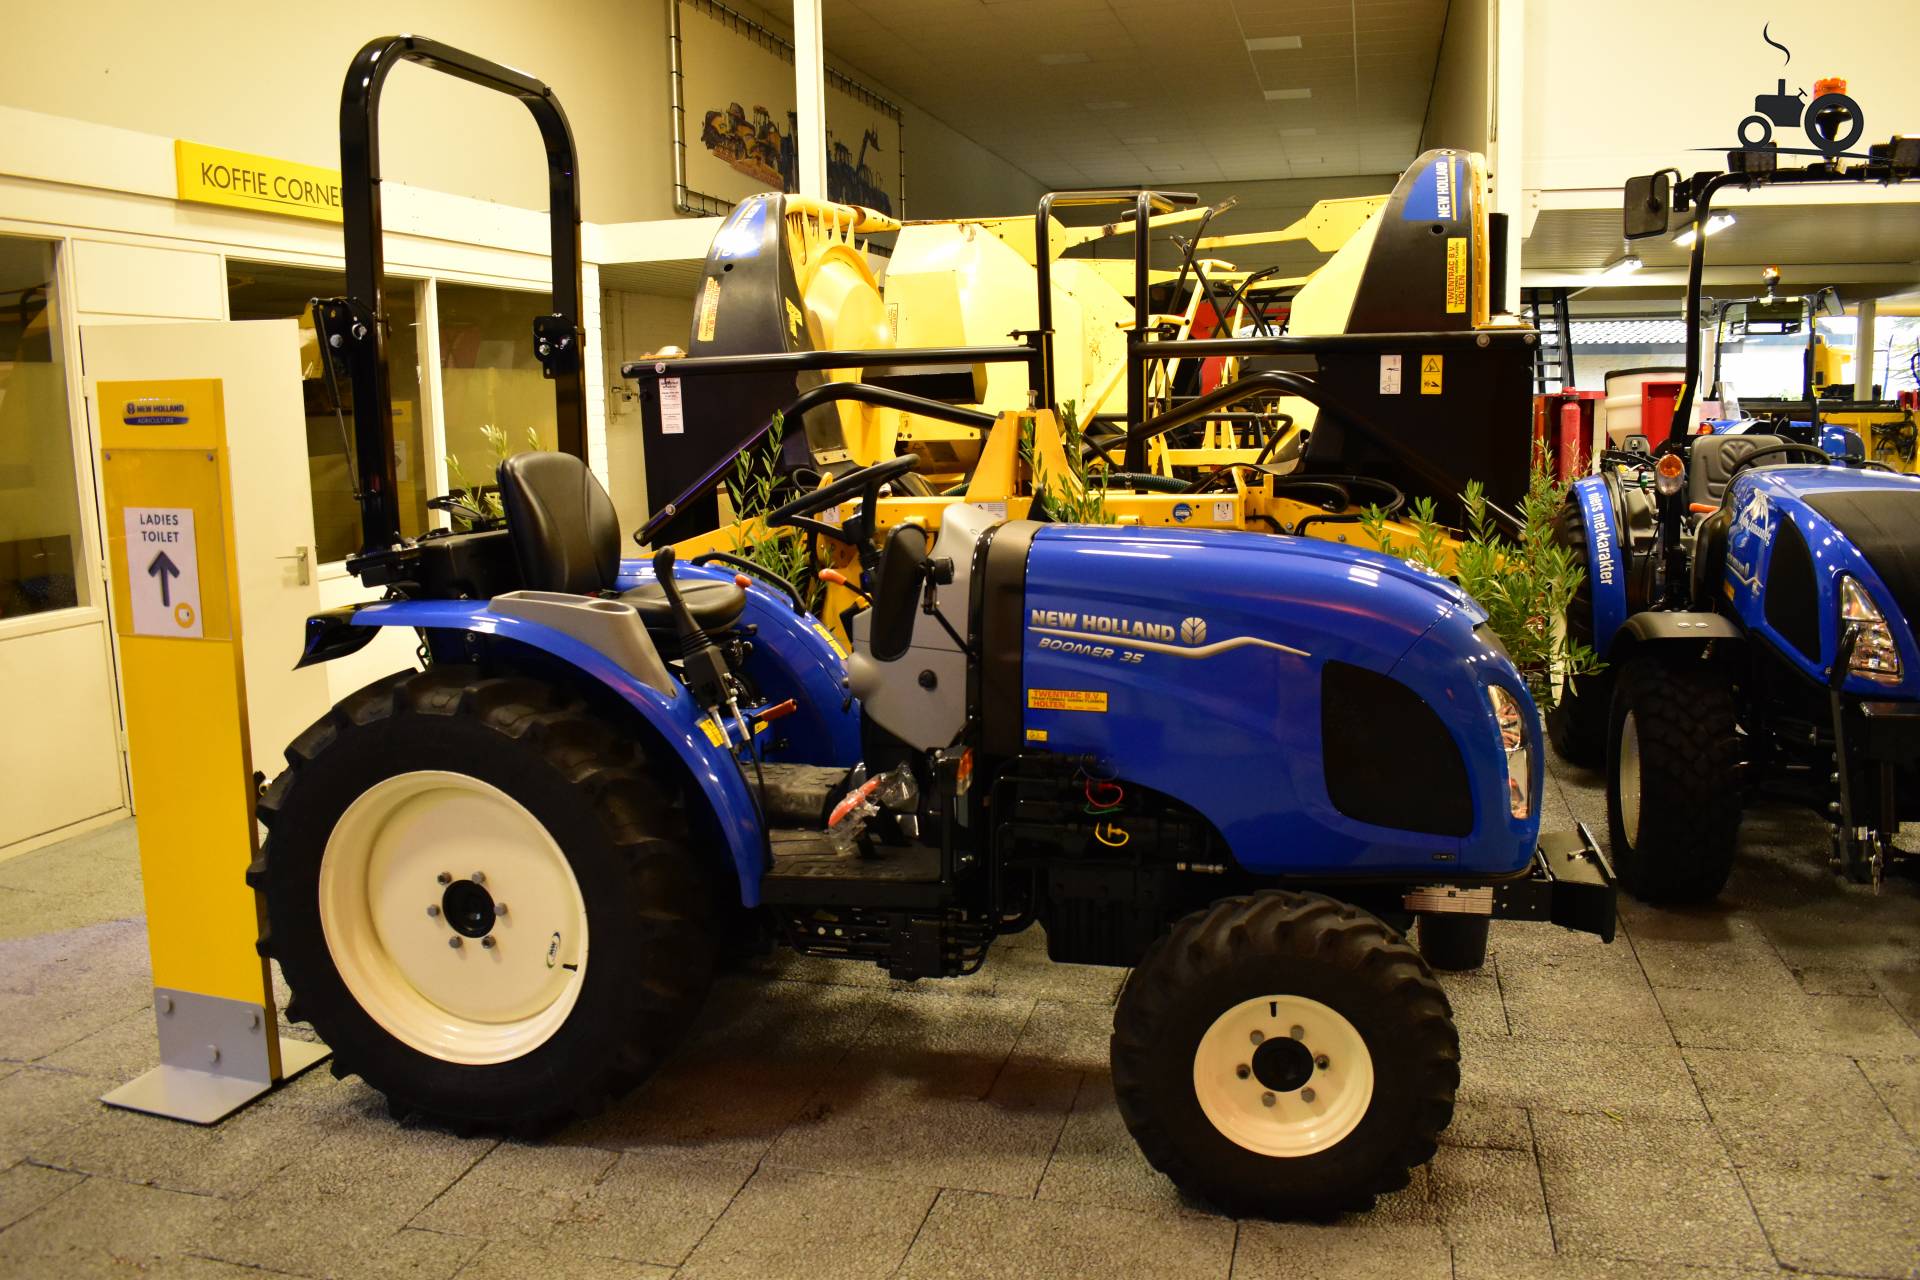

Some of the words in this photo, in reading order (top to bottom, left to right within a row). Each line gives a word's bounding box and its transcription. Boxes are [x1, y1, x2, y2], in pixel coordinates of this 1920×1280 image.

[201, 162, 268, 195] KOFFIE
[1435, 161, 1449, 194] HOLLAND
[1437, 195, 1451, 218] NEW
[1447, 260, 1455, 305] TWENTRAC
[153, 404, 184, 413] HOLLAND
[140, 512, 179, 526] LADIES
[1592, 513, 1610, 534] met
[141, 530, 179, 543] TOILET
[1596, 533, 1615, 585] karakter
[1031, 609, 1078, 628] NEW
[1082, 614, 1176, 642] HOLLAND
[1038, 637, 1115, 659] BOOMER
[1119, 651, 1145, 664] 35
[1031, 690, 1082, 698] TWENTRAC
[1032, 700, 1066, 708] HOLTEN
